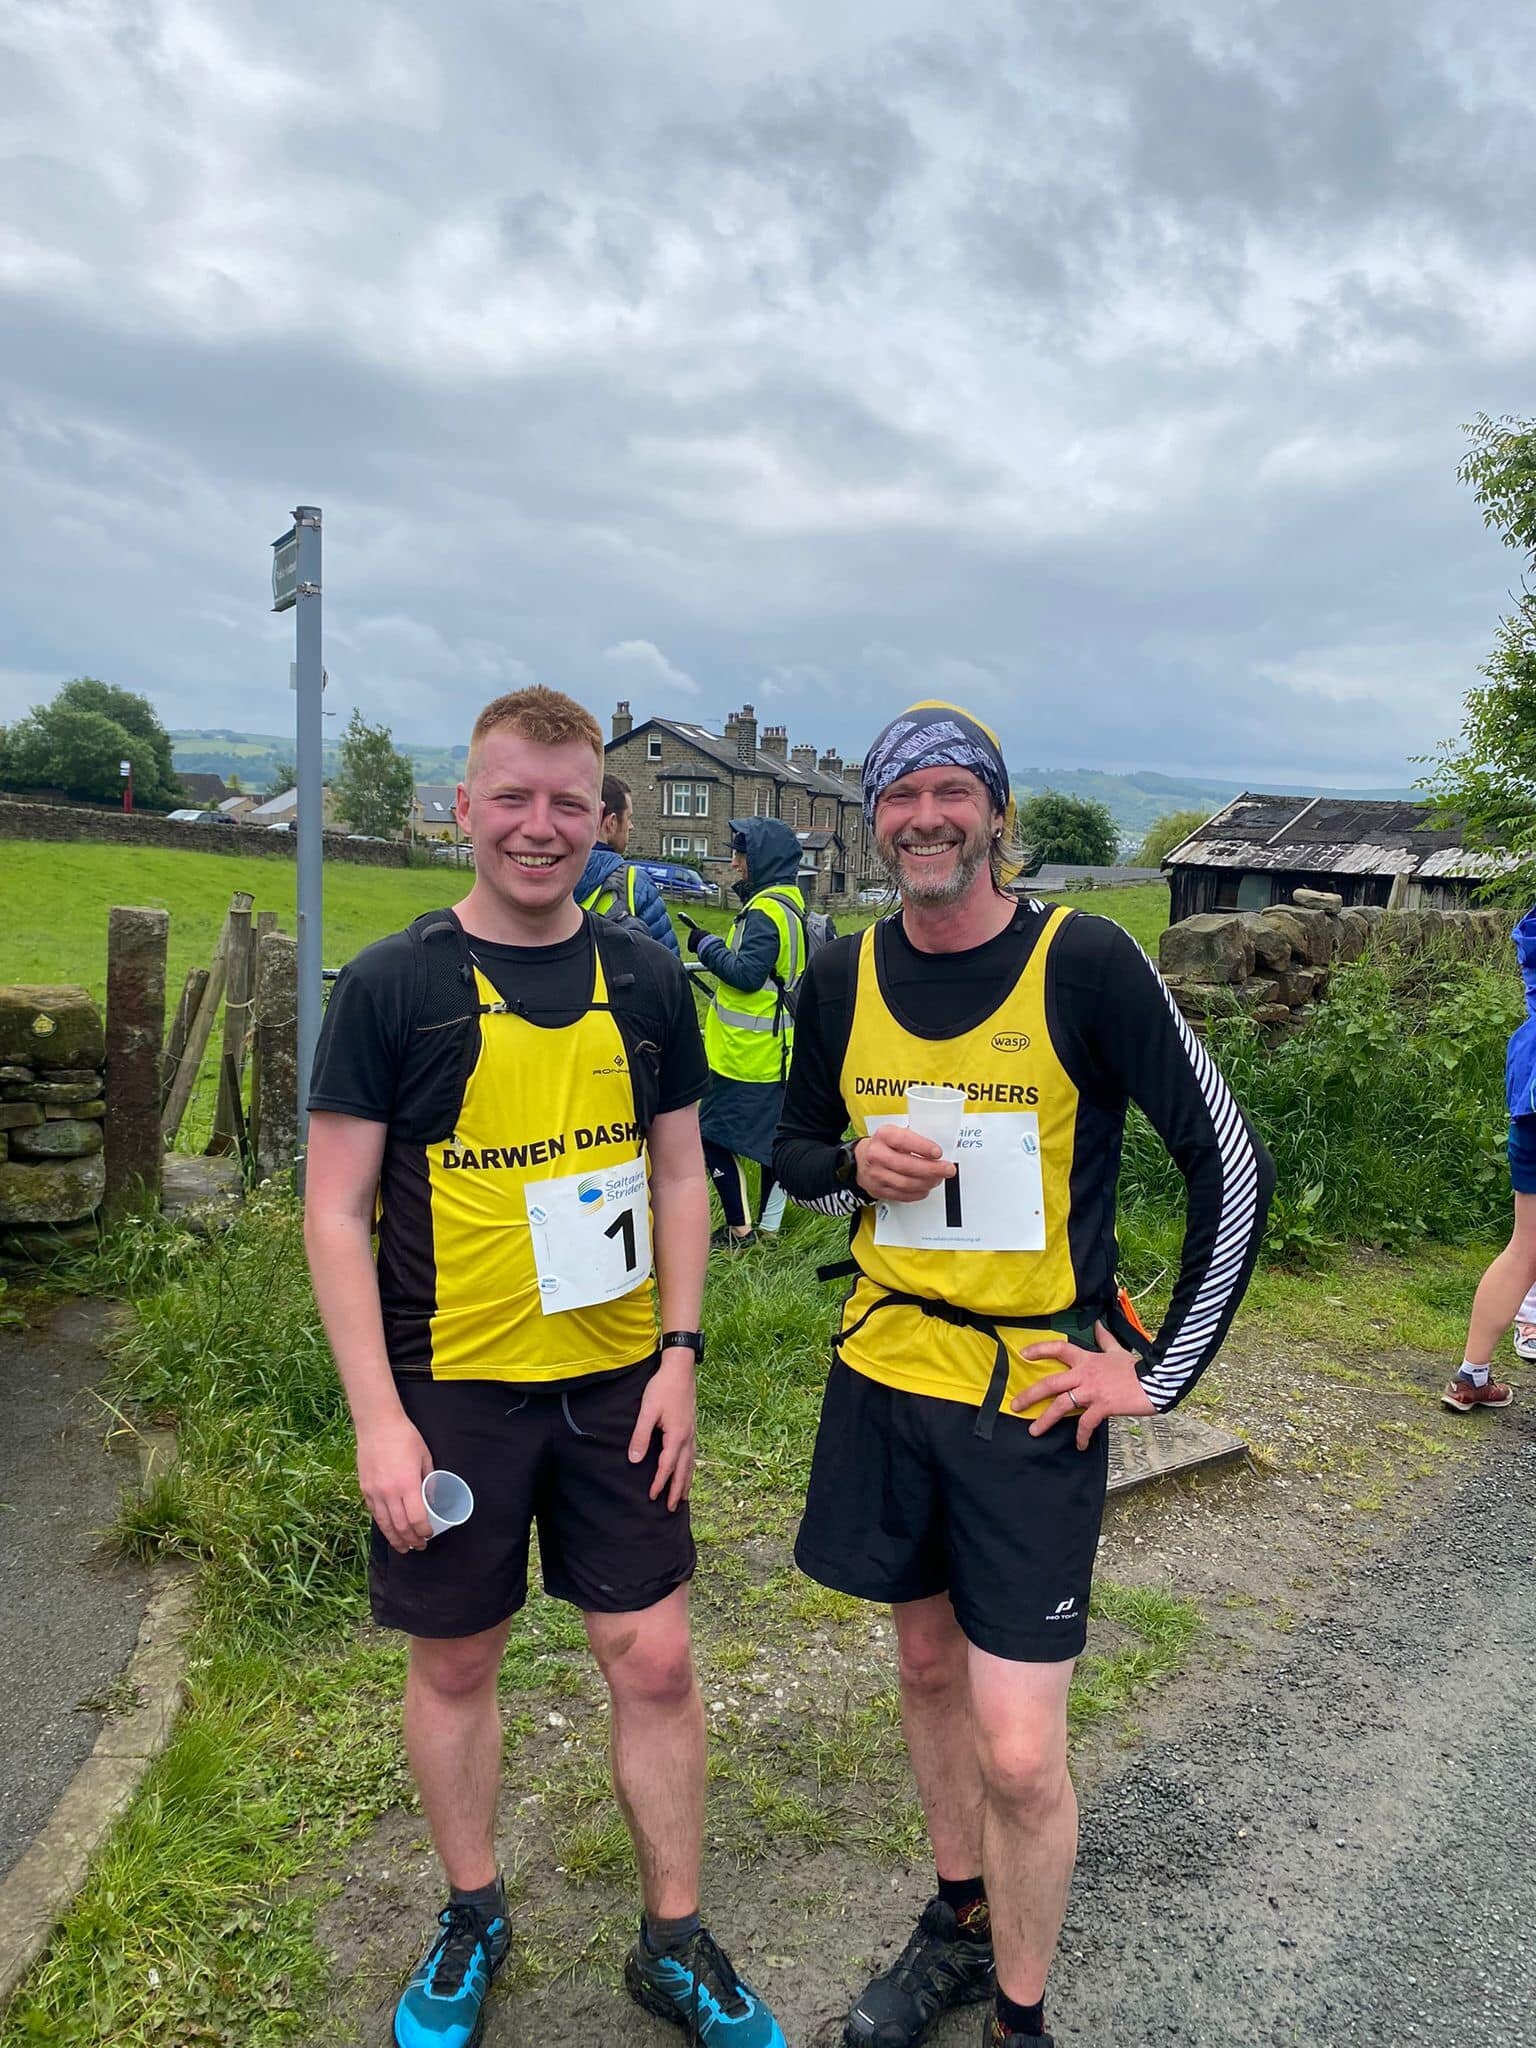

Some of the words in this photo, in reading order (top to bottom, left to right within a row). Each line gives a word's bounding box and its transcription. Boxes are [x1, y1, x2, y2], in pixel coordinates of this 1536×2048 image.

[994, 1037, 1028, 1051] wasp
[442, 1135, 565, 1169] DARWEN
[574, 1121, 641, 1150] DASH
[603, 1208, 637, 1273] 1
